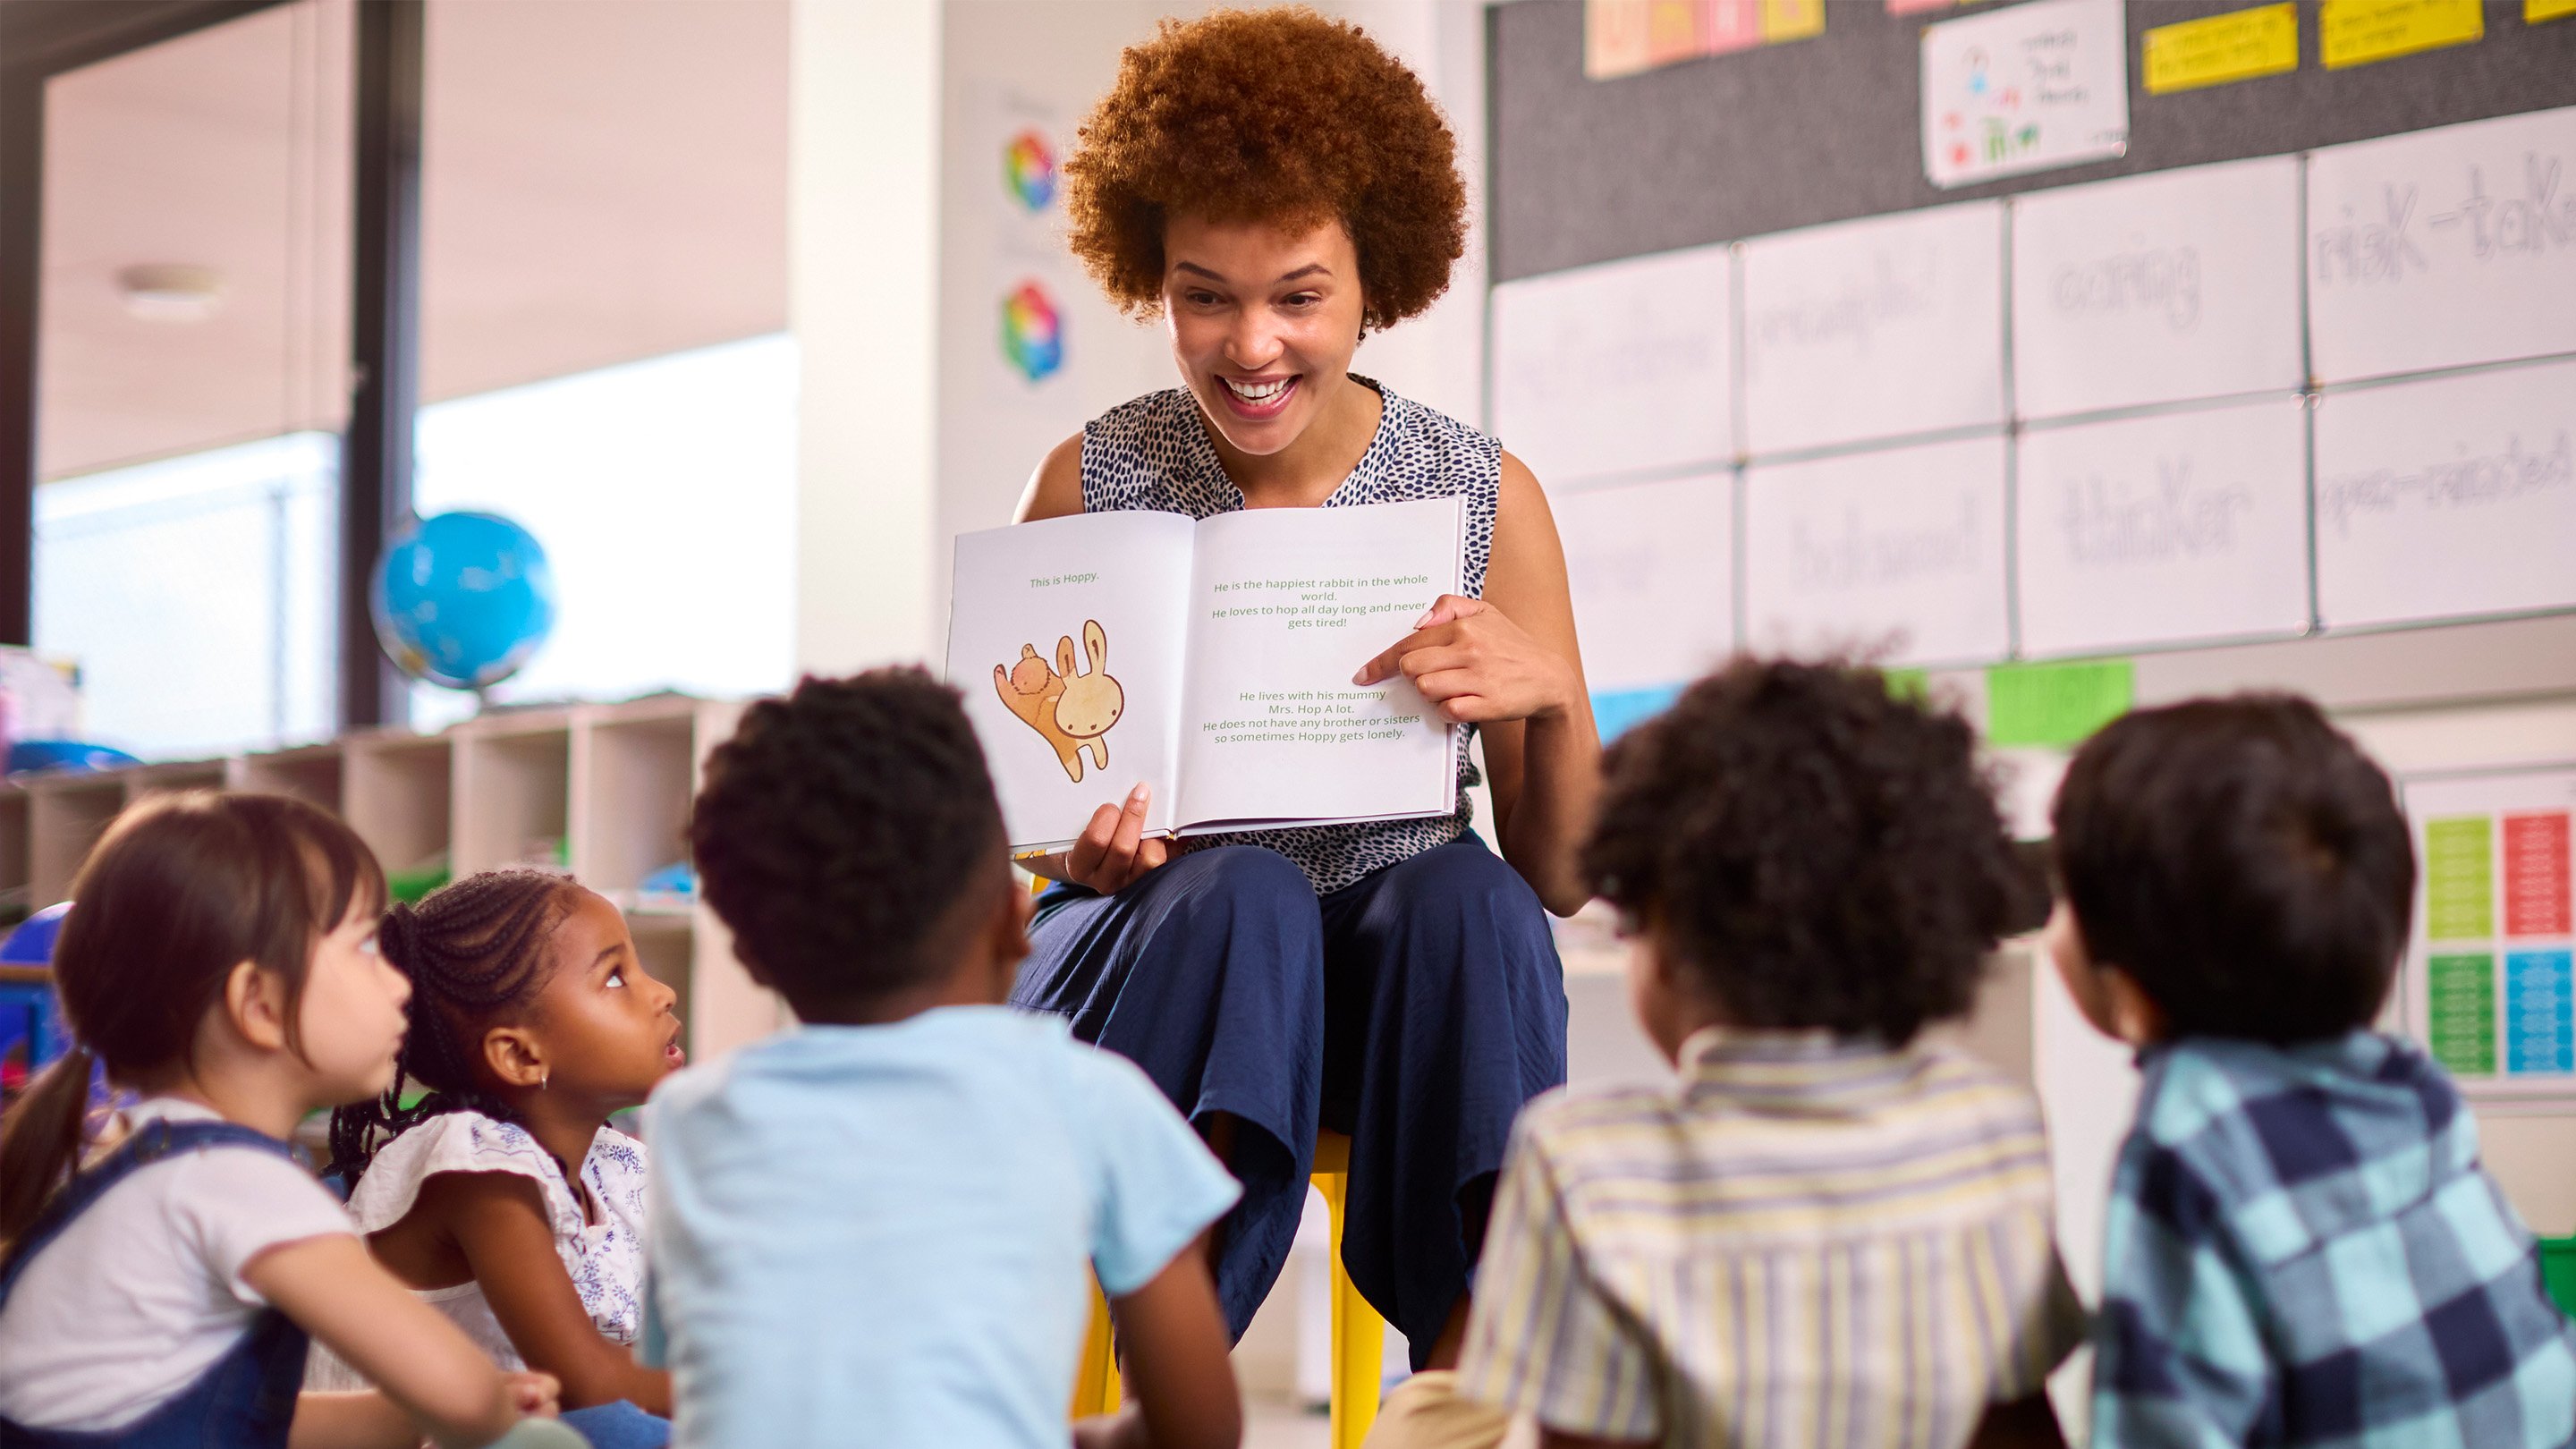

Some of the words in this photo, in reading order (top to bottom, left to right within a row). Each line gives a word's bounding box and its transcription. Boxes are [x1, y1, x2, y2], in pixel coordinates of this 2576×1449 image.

[1030, 577, 1051, 589] This
[1052, 575, 1061, 586] is
[1063, 572, 1100, 585] Hoppy.
[1214, 583, 1229, 593] He
[1232, 580, 1241, 591] is
[1243, 580, 1263, 590] the
[1265, 578, 1317, 591] happiest
[1318, 578, 1355, 589] rabbit
[1357, 578, 1368, 588] in
[1371, 576, 1391, 587] the
[1393, 573, 1428, 586] whole
[1301, 591, 1337, 602] world.
[1212, 608, 1227, 620] He
[1229, 607, 1259, 617] loves
[1261, 606, 1274, 615] to
[1275, 605, 1299, 617] hop
[1301, 604, 1315, 614] all
[1318, 605, 1340, 617] day
[1341, 605, 1367, 616] long
[1368, 602, 1392, 614] and
[1394, 602, 1428, 612] never
[1287, 619, 1313, 631] gets
[1316, 617, 1347, 628] tired!
[1239, 691, 1256, 701] He
[1258, 691, 1285, 701] lives
[1287, 691, 1314, 701] with
[1317, 691, 1335, 700] his
[1337, 691, 1386, 702] mummy
[1268, 704, 1294, 715] Mrs.
[1297, 704, 1322, 716] Hop
[1324, 704, 1334, 714] A
[1335, 704, 1355, 715] lot.
[1202, 722, 1218, 733] He
[1219, 719, 1248, 730] does
[1248, 718, 1268, 728] not
[1269, 717, 1298, 728] have
[1300, 719, 1321, 731] any
[1323, 716, 1368, 729] brother
[1368, 717, 1382, 726] or
[1383, 715, 1420, 725] sisters
[1214, 735, 1228, 744] so
[1230, 731, 1295, 742] sometimes
[1298, 732, 1337, 744] Hoppy
[1338, 731, 1365, 744] gets
[1367, 728, 1407, 741] lonely.
